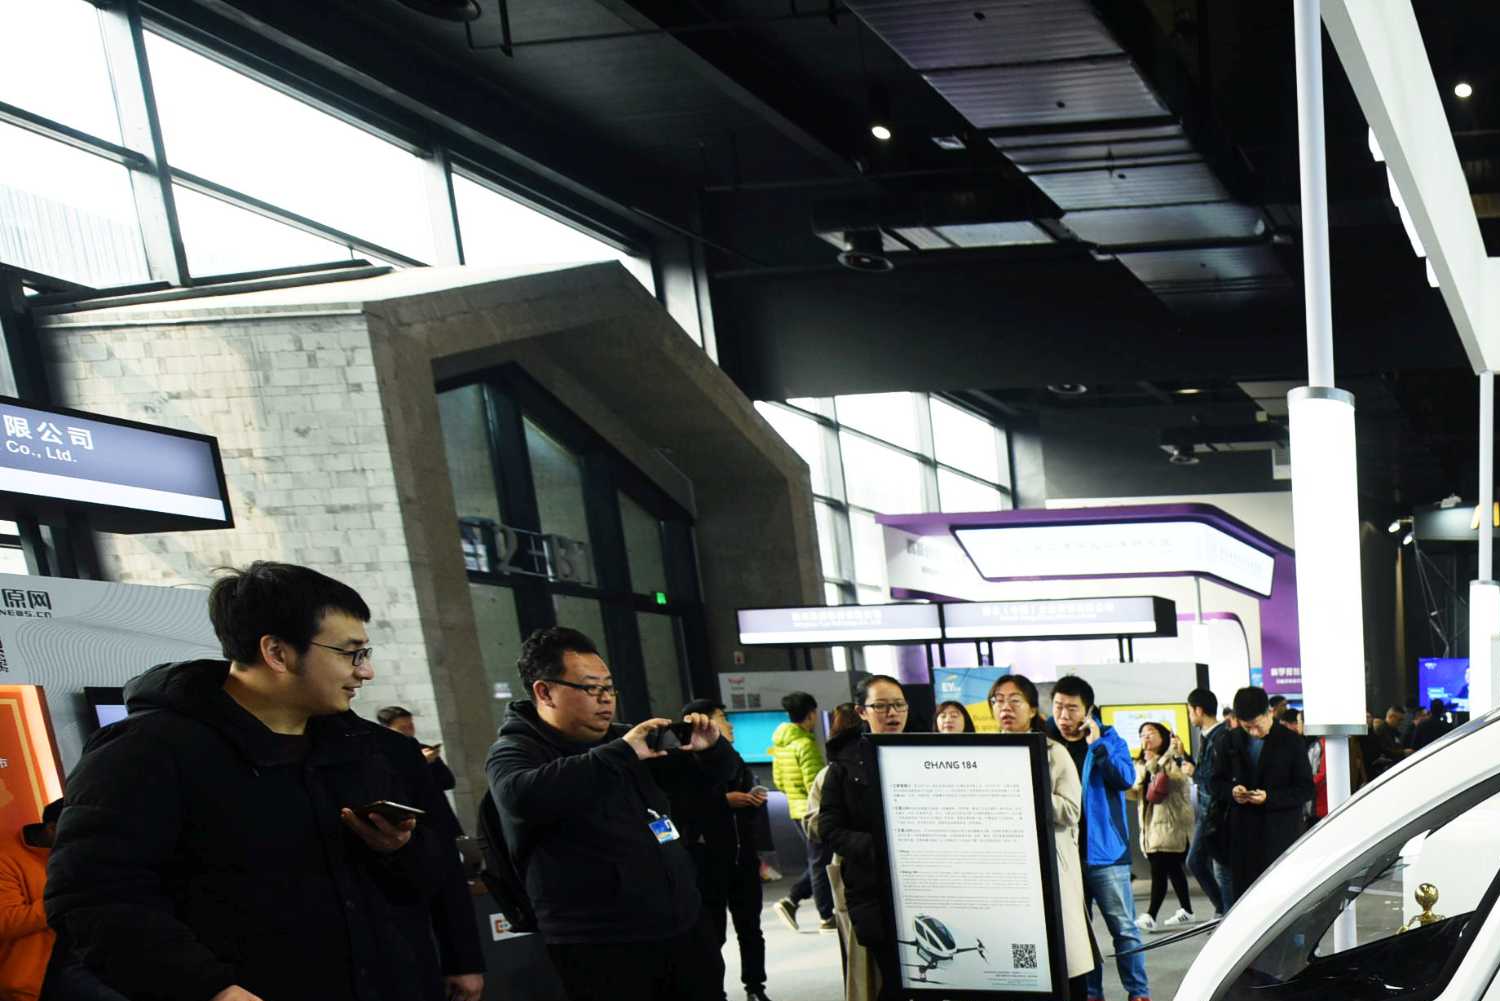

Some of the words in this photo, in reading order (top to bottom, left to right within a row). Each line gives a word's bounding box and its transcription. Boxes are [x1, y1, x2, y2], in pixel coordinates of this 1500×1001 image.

[3, 415, 94, 450] 限公司
[6, 440, 42, 459] Co.,
[47, 447, 78, 463] Ltd.
[1, 588, 52, 610] 原网
[962, 760, 978, 769] 184
